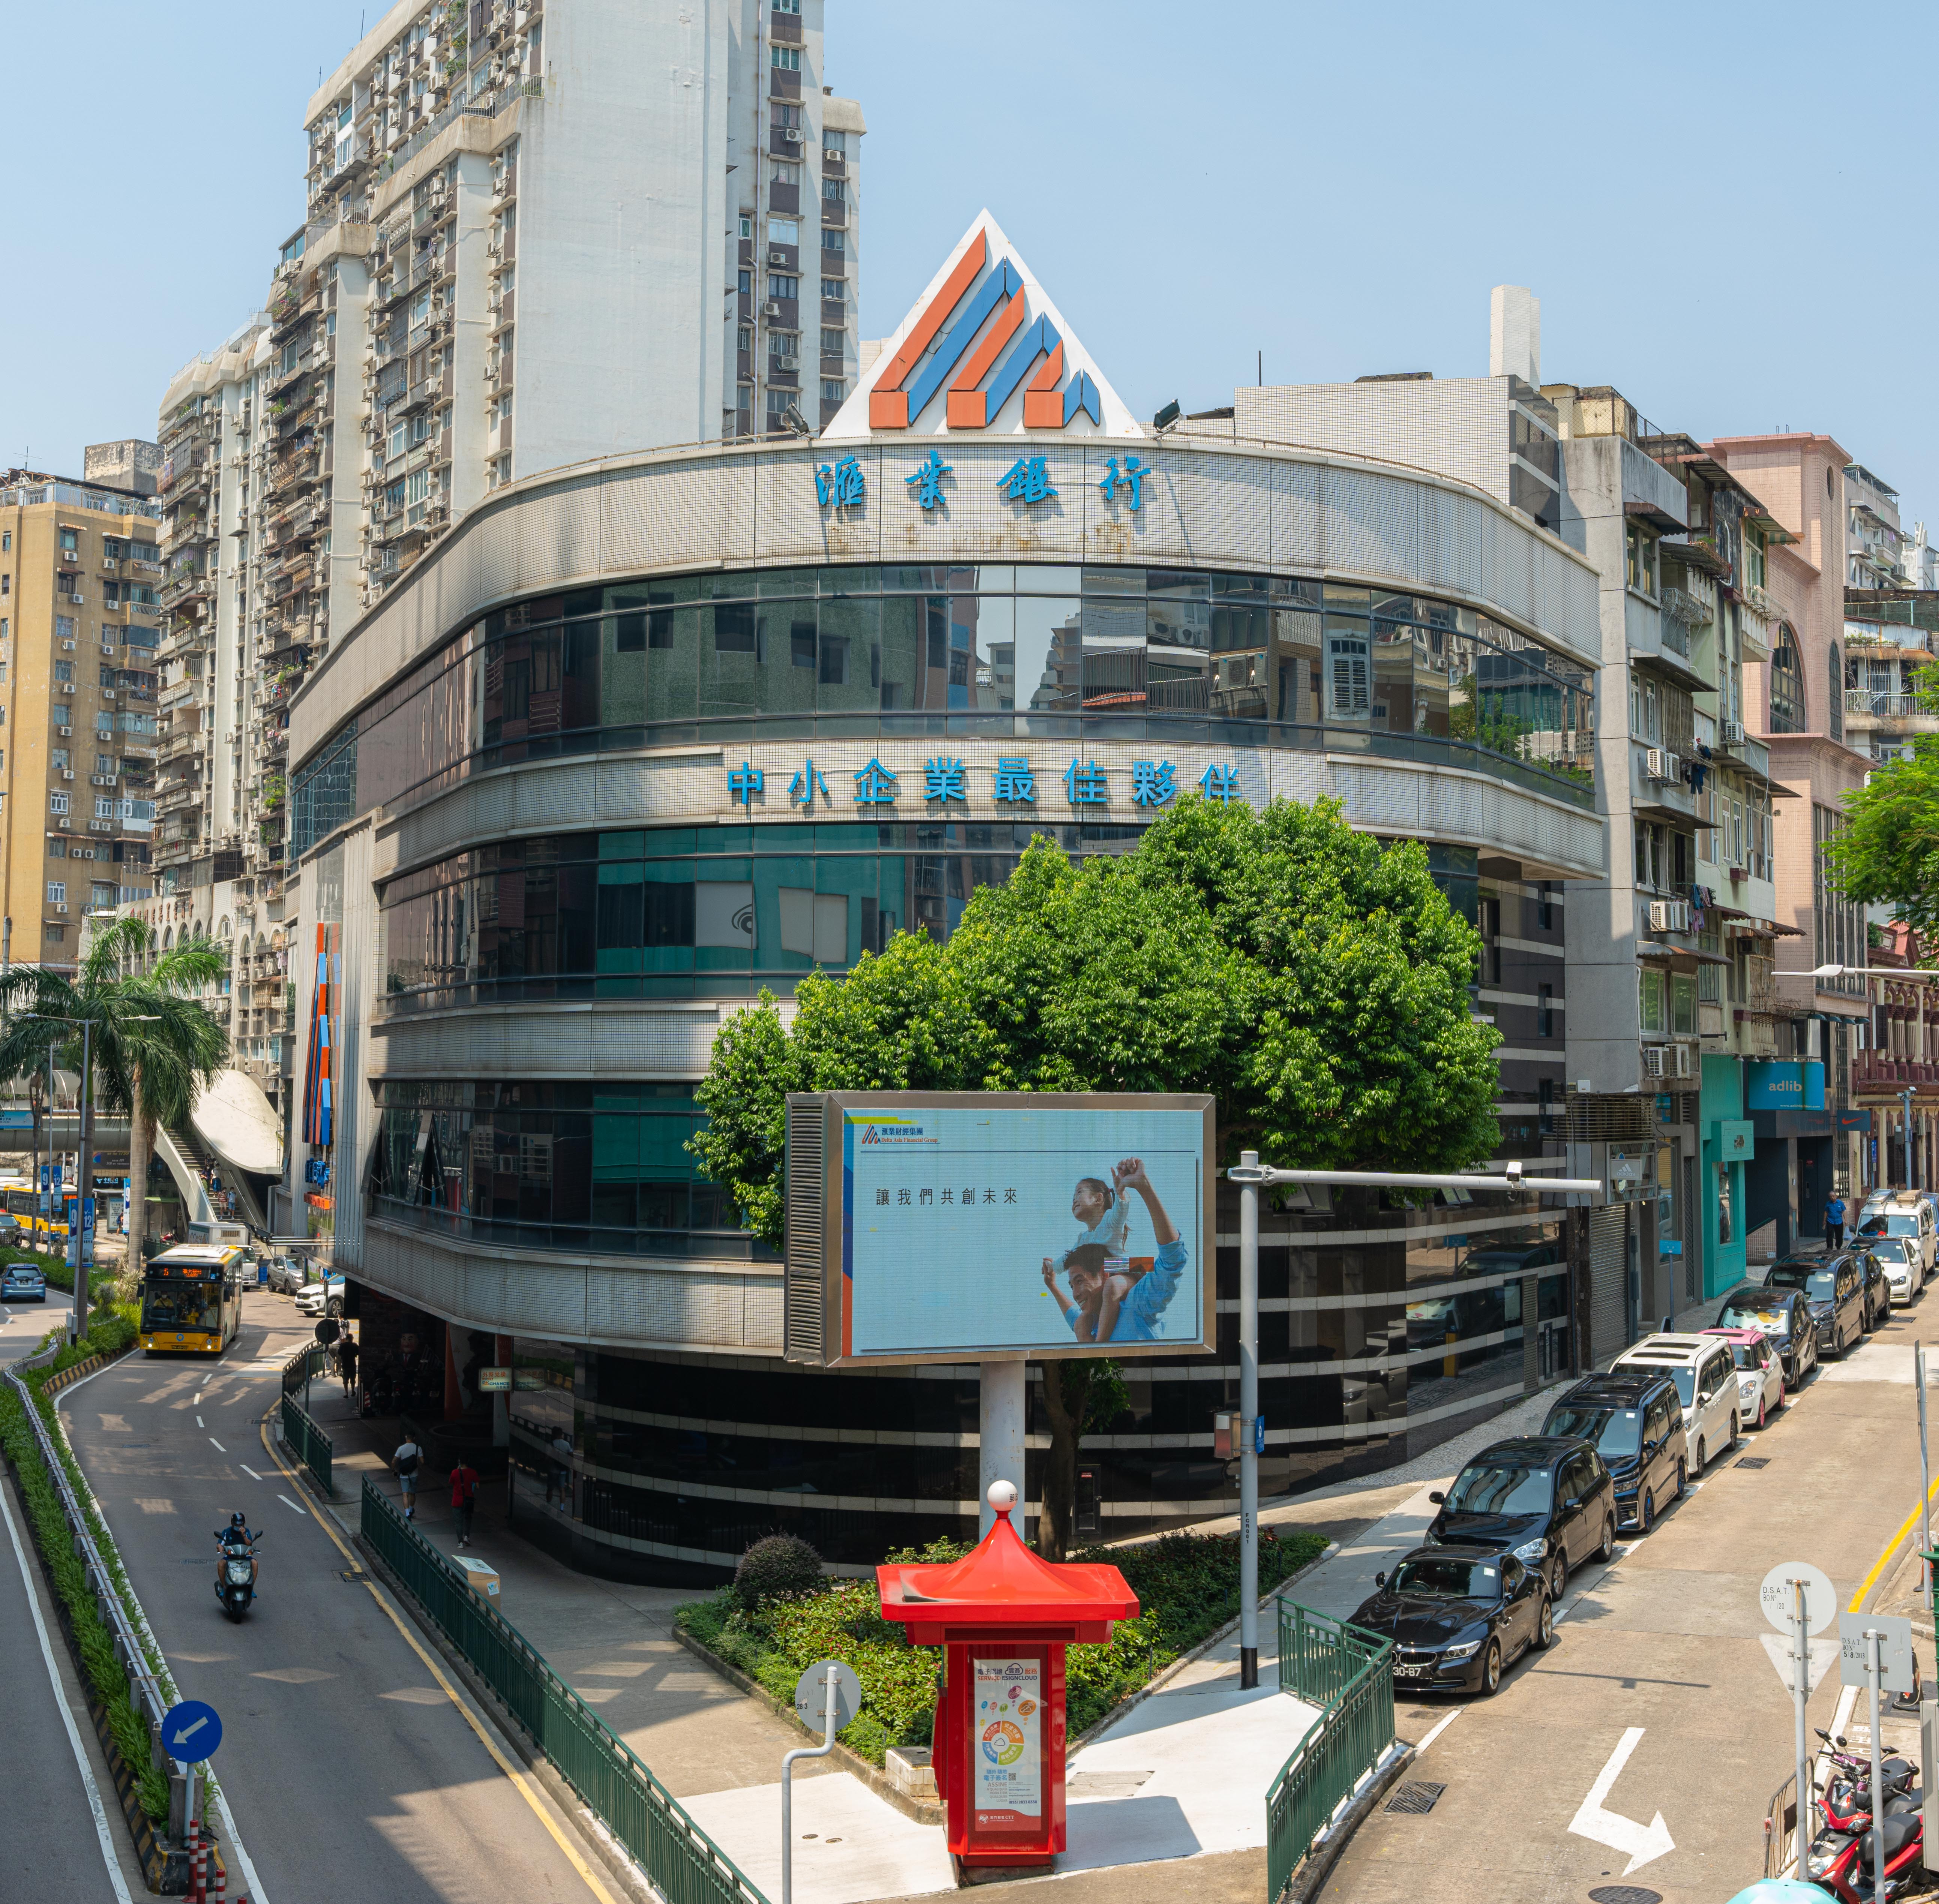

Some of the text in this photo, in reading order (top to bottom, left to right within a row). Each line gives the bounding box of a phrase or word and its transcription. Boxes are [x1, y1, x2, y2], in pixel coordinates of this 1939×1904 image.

[728, 757, 1241, 808] 中小企業最佳夥伴
[1769, 1081, 1802, 1091] adlib
[54, 1177, 61, 1186] 12
[126, 1187, 130, 1202] 9
[876, 1187, 1017, 1205] 讓我們共創未來
[84, 1216, 92, 1228] 12
[1392, 1667, 1421, 1676] 30-87
